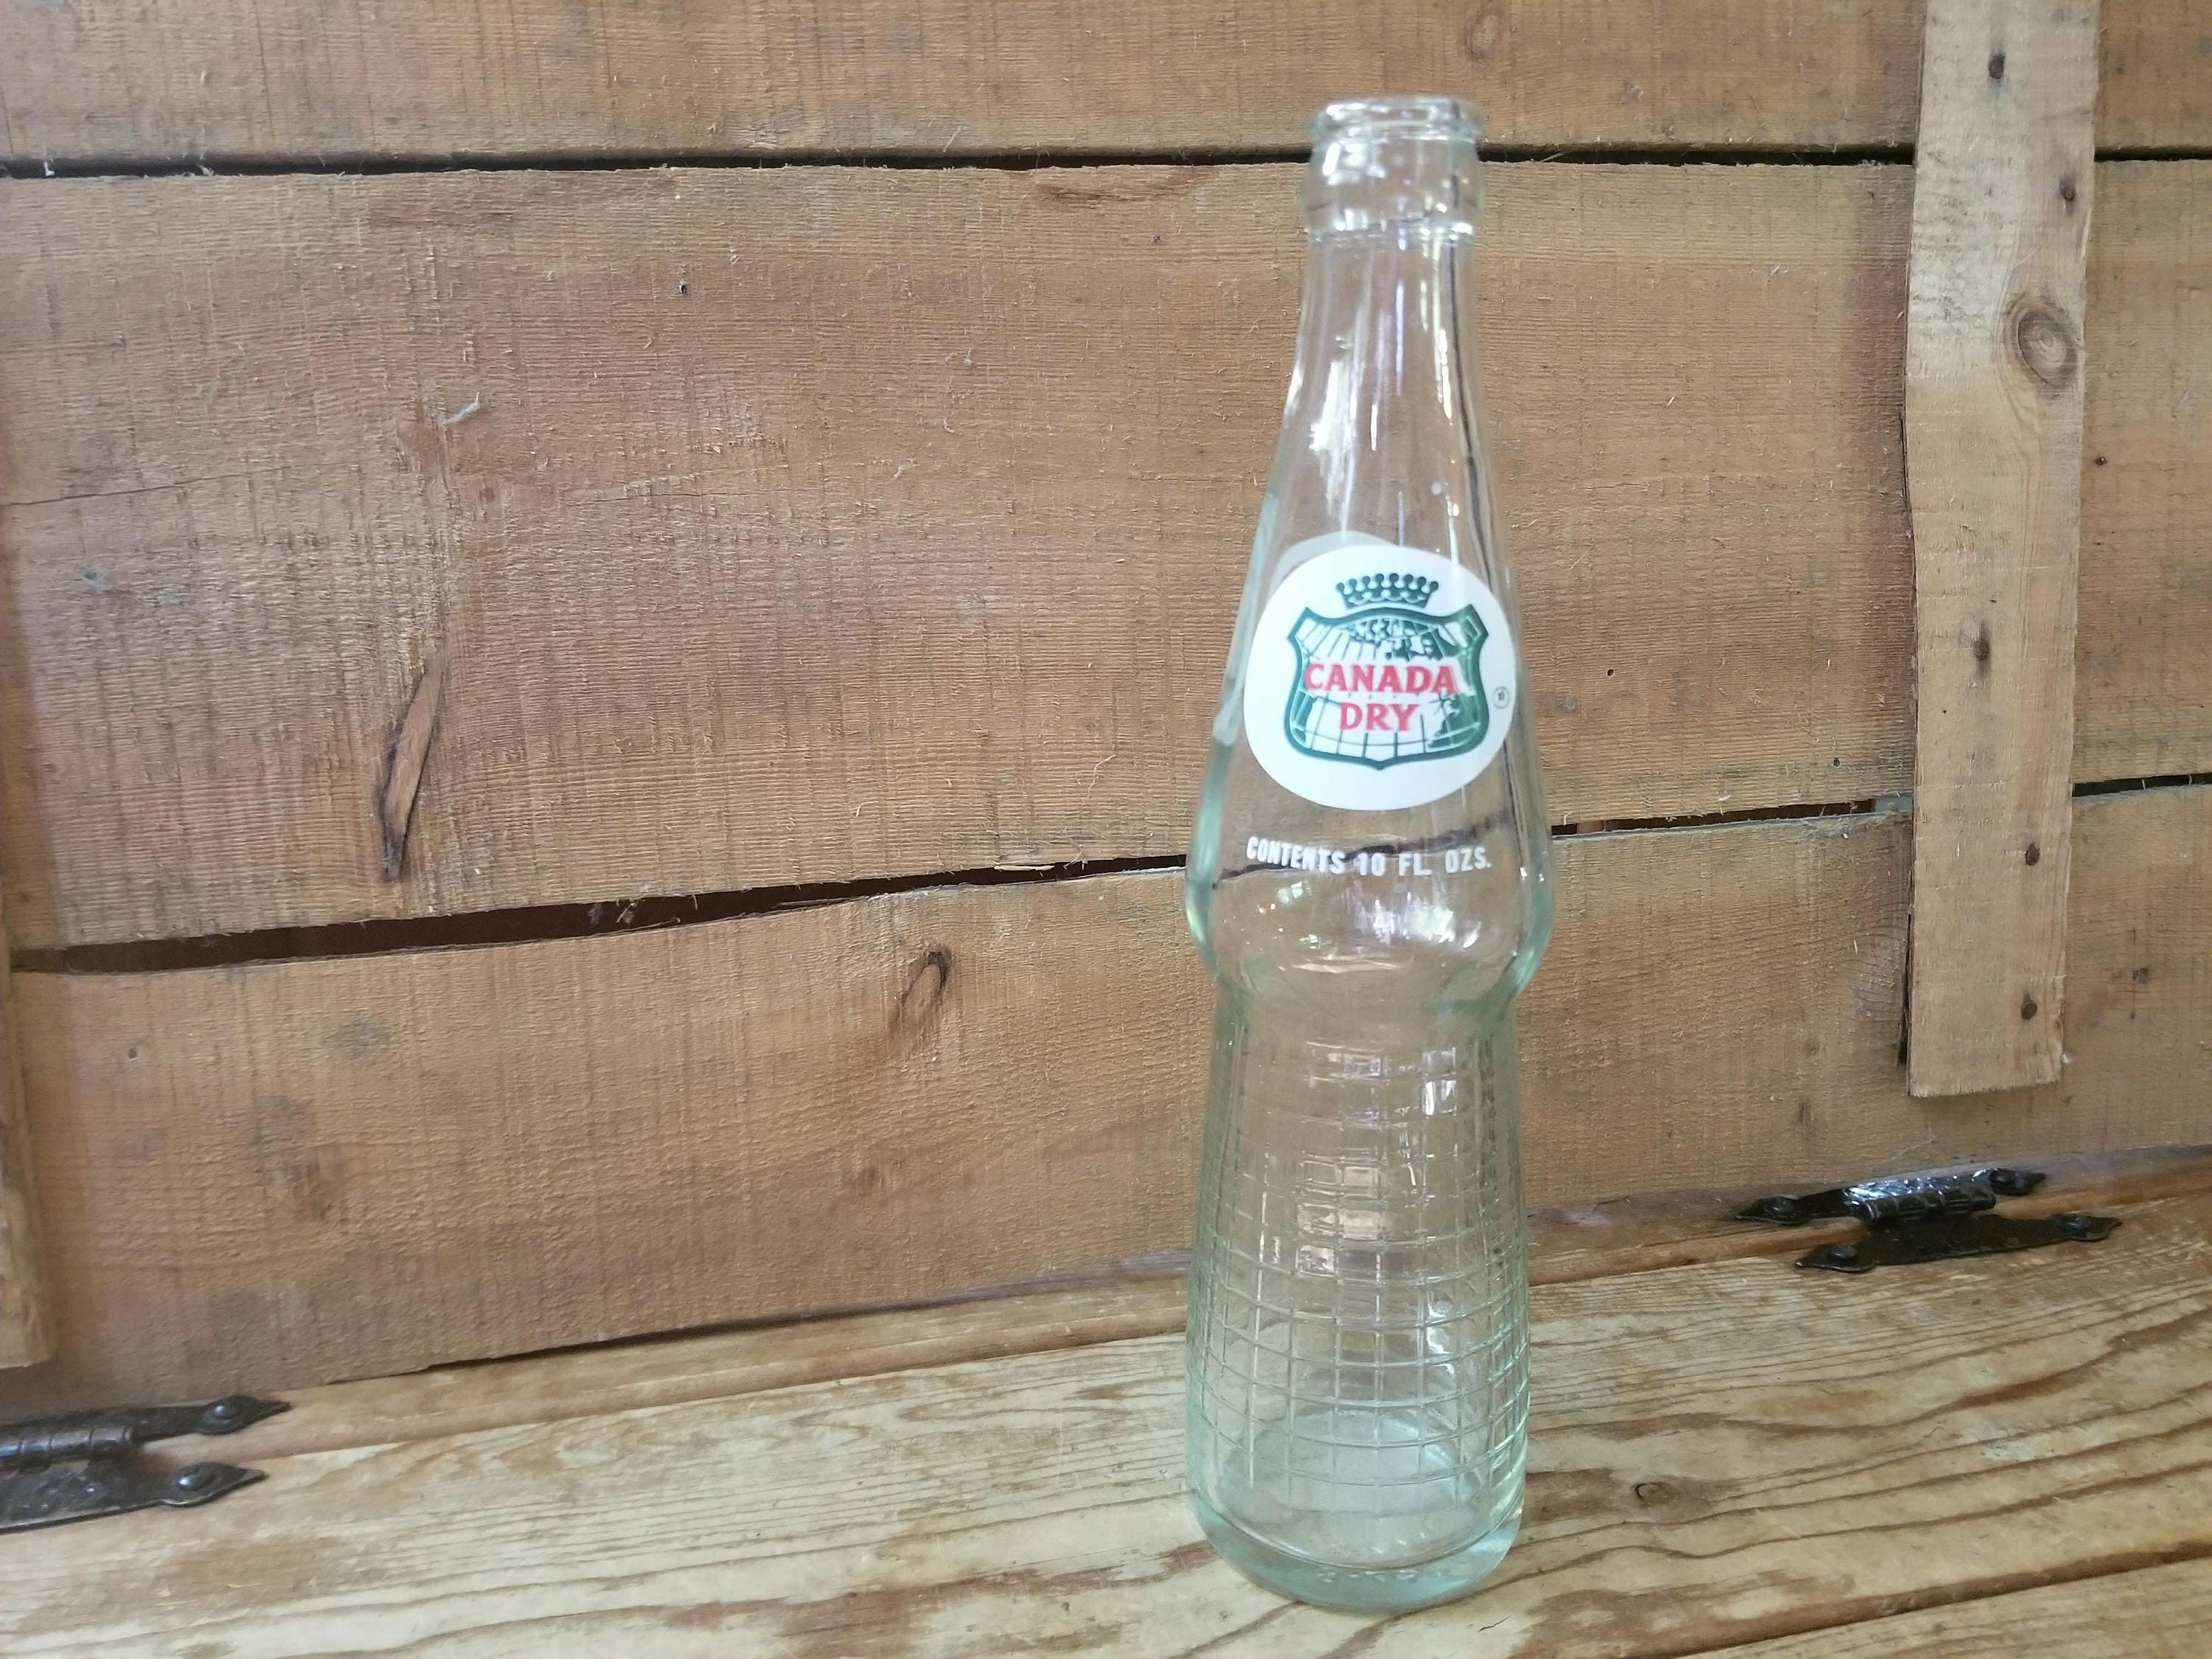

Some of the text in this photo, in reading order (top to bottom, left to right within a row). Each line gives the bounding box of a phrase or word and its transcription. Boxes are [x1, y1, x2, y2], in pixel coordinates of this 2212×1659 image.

[1304, 662, 1458, 694] CANADA
[1339, 703, 1419, 731] DRY
[1246, 835, 1346, 874] CONTENTS
[1354, 852, 1386, 876] 10
